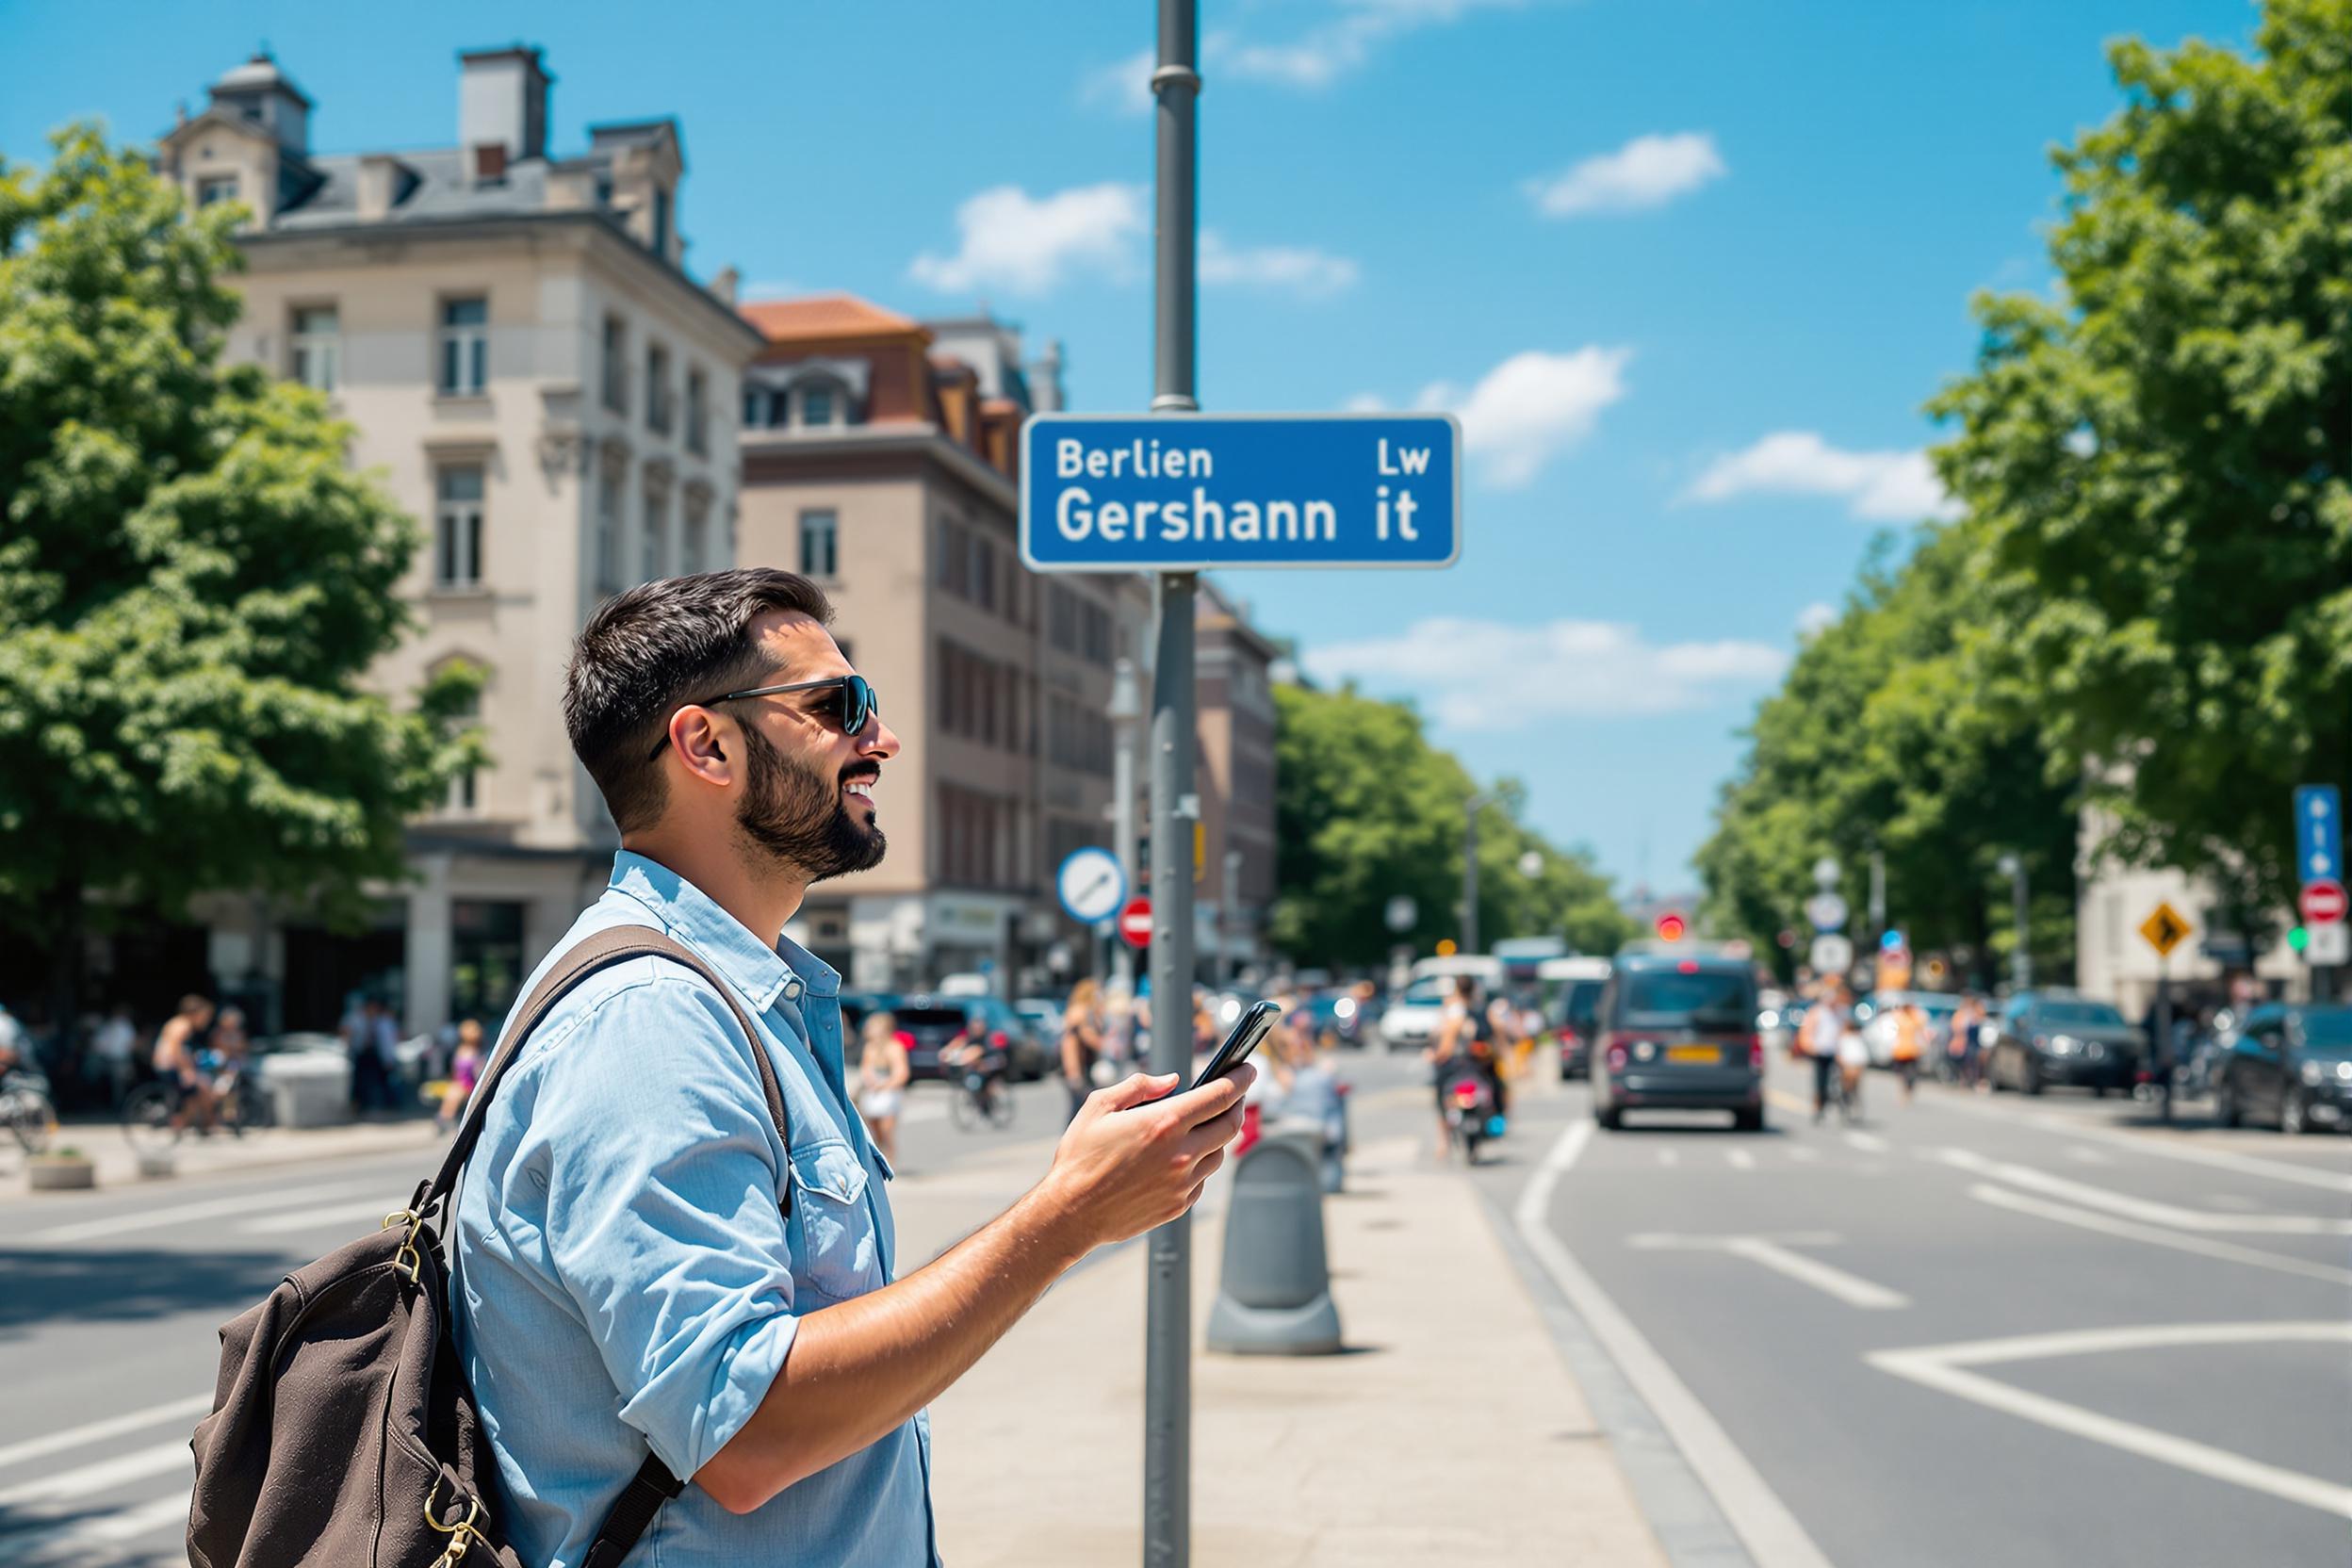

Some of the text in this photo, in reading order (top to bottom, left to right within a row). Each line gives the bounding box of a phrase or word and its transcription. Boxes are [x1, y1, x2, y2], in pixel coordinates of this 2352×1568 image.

[1056, 438, 1430, 477] Berlien Lw
[1056, 486, 1418, 541] Gershann it
